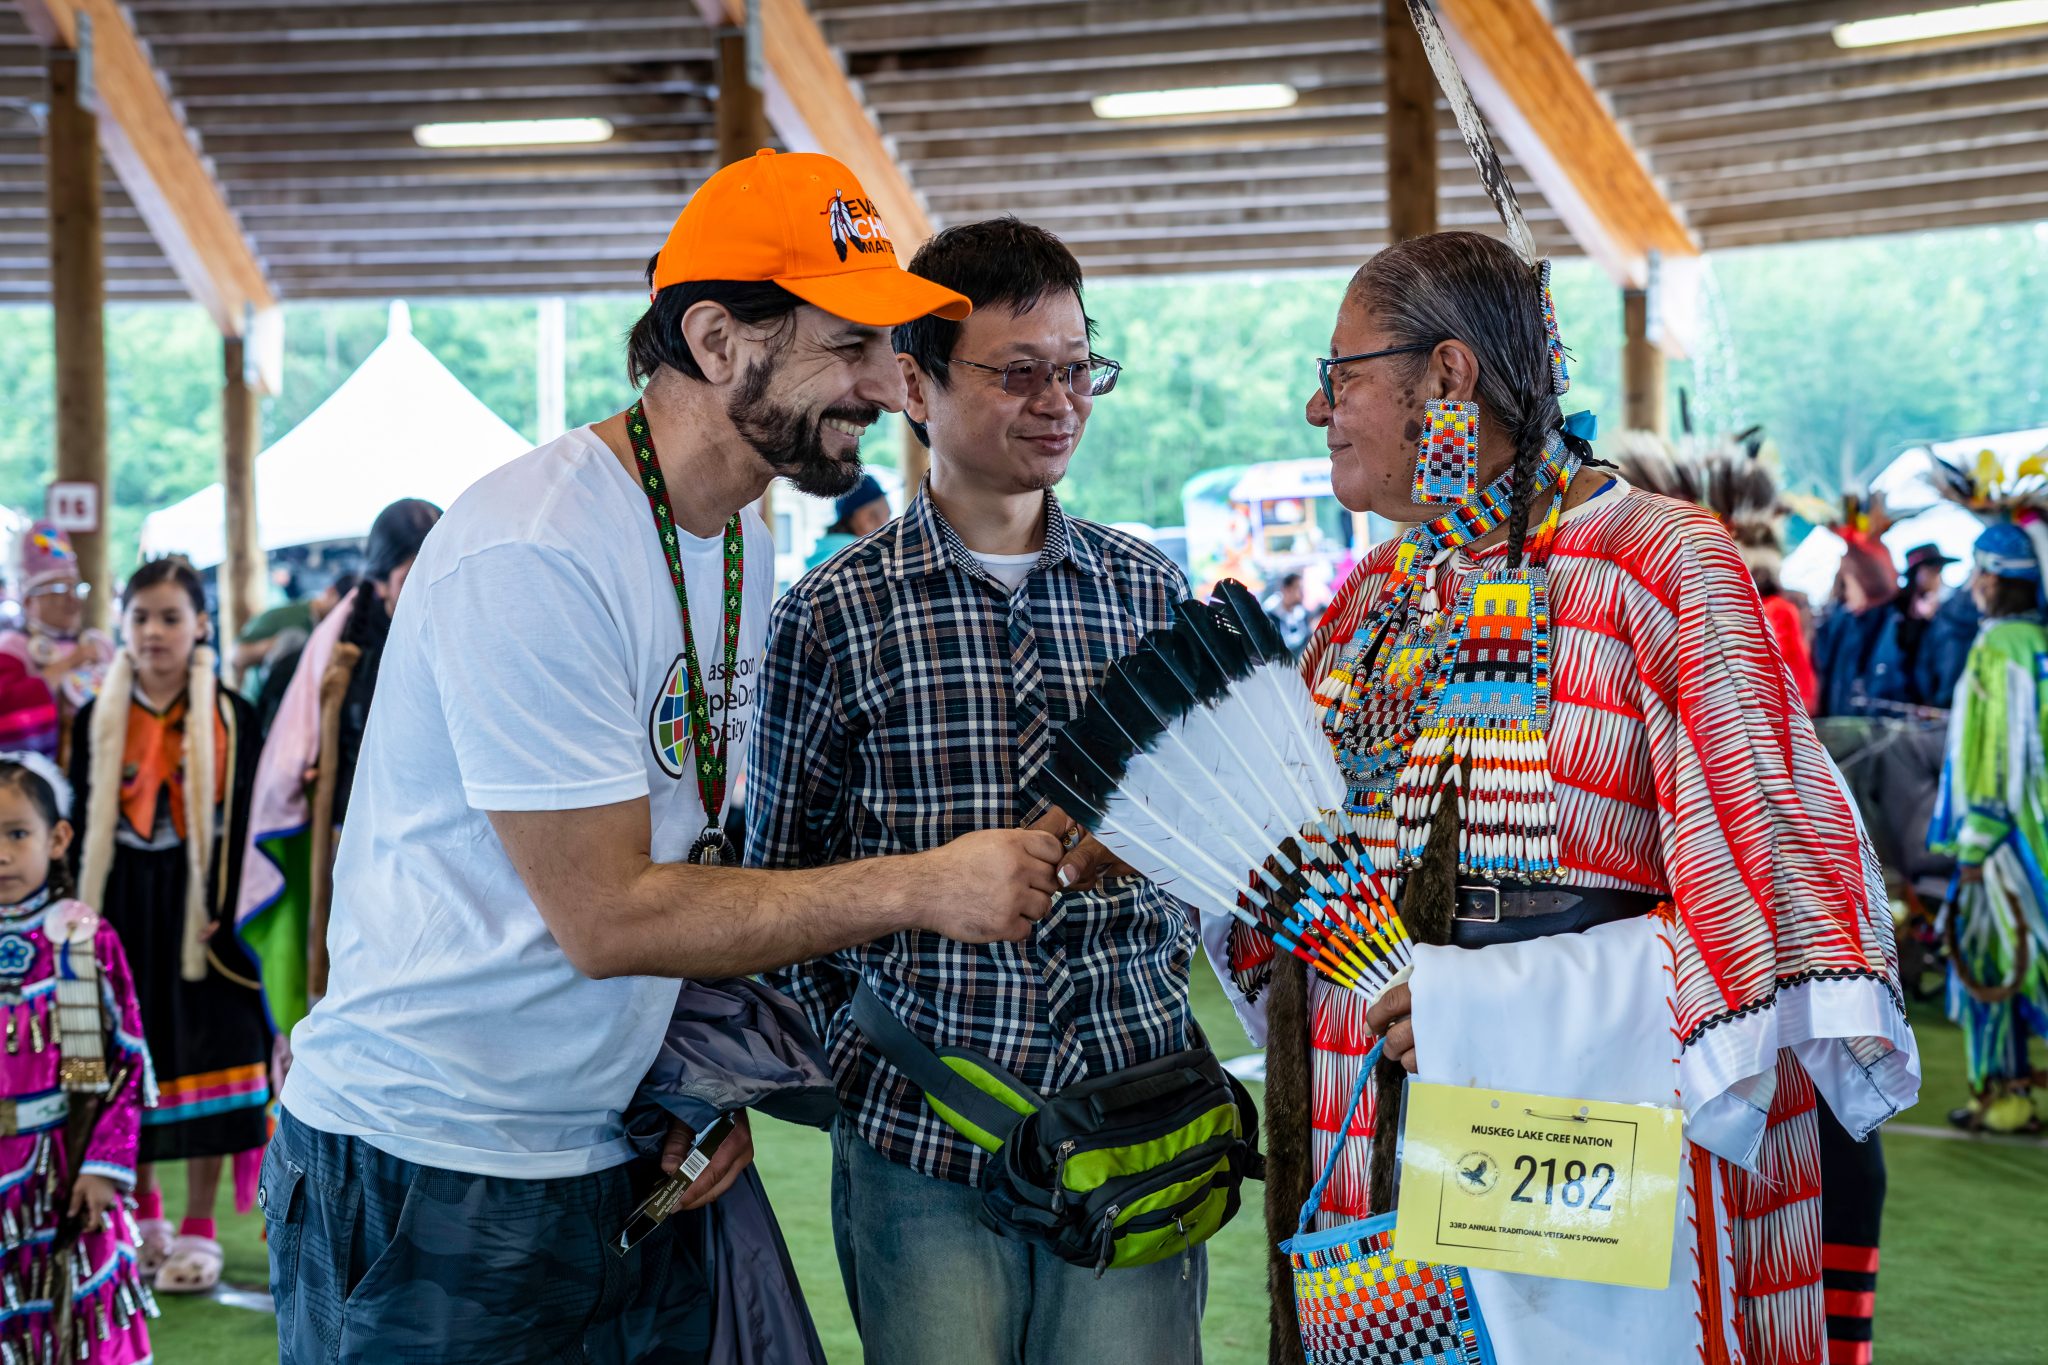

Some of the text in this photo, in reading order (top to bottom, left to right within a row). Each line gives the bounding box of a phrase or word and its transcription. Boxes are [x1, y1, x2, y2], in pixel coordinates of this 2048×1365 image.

[1471, 1124, 1613, 1148] MUSKEG LAKE CREE NATION
[1510, 1154, 1615, 1211] 2182
[1449, 1221, 1619, 1245] 33RD ANNUAL TRADITIONAL VETERAN'S POWWOW
